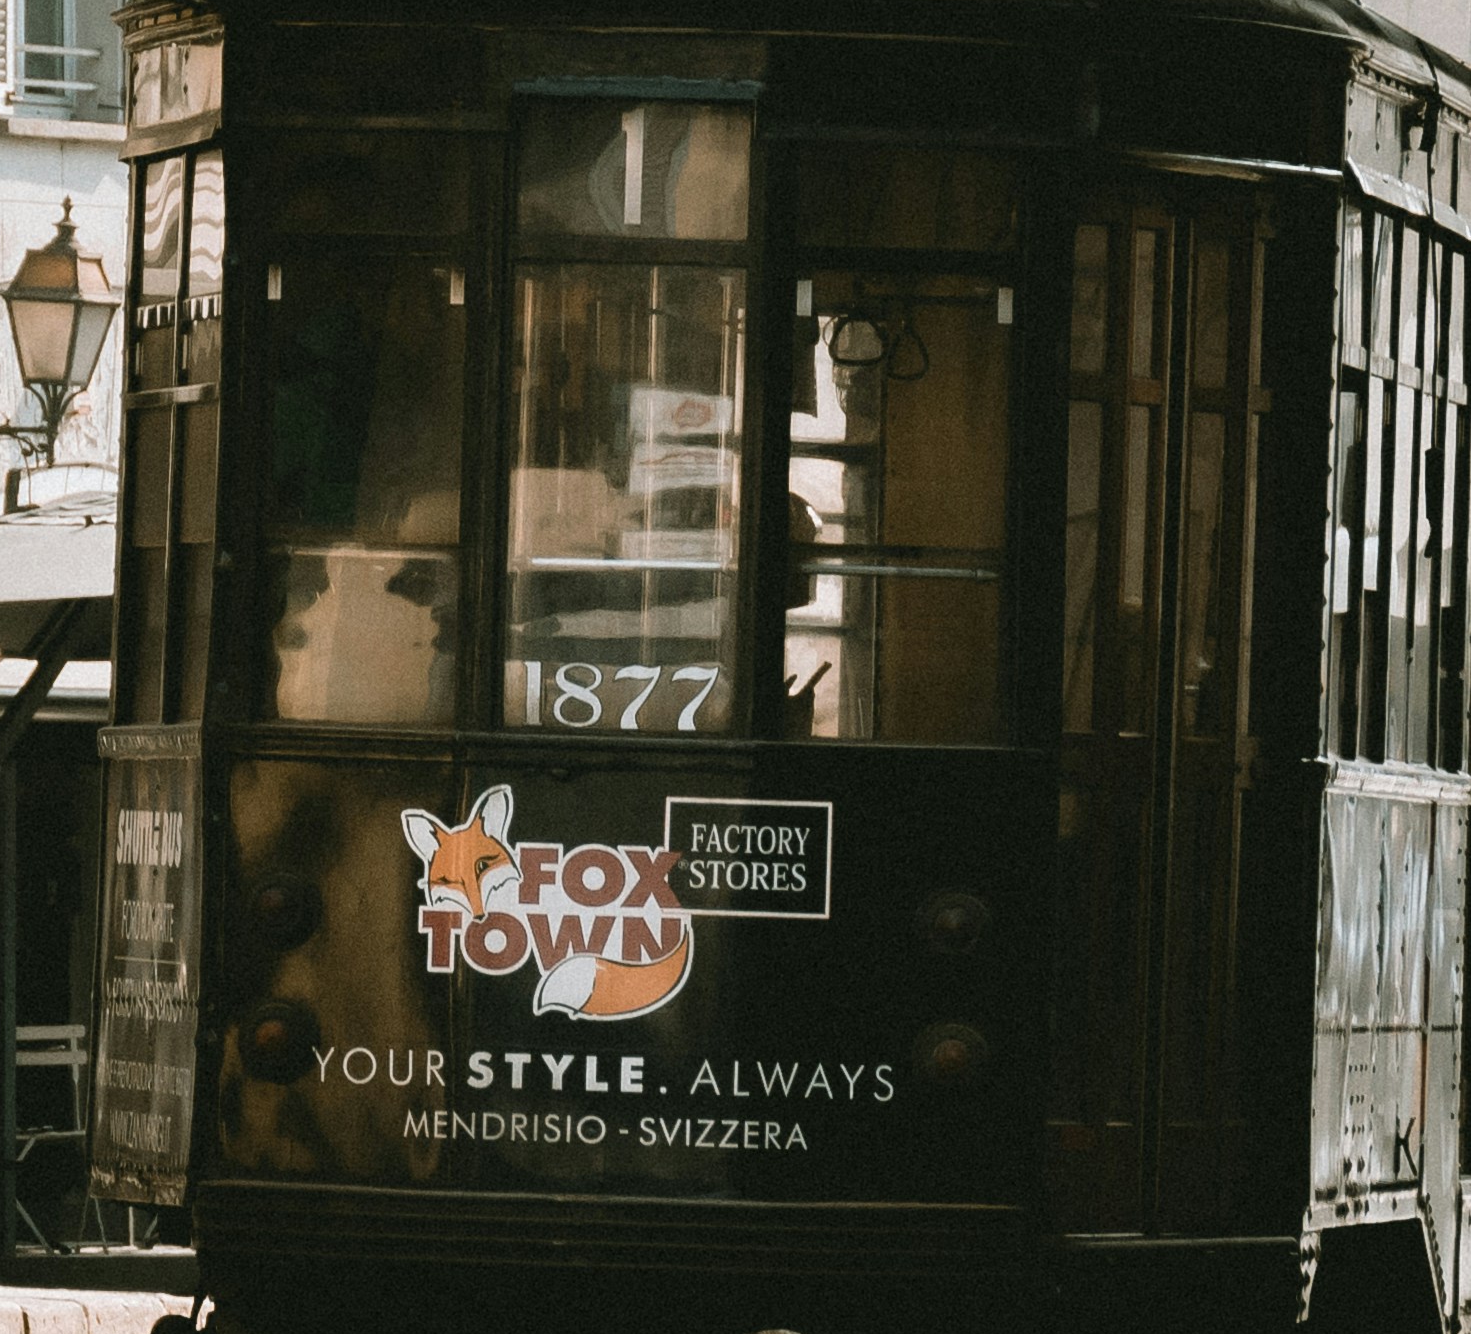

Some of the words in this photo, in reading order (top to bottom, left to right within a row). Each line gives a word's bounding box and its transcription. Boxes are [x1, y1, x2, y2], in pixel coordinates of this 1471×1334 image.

[622, 108, 644, 224] 1
[524, 661, 719, 731] 1877
[117, 809, 160, 865] SHUTTLE
[161, 811, 183, 868] BUS
[691, 822, 810, 855] FACTORY
[519, 846, 683, 907] FOX
[689, 861, 808, 892] STORES
[421, 910, 684, 970] TOWN
[313, 1046, 445, 1087] YOUR
[467, 1053, 668, 1094] STYLE.
[690, 1059, 896, 1102] ALWAYS
[404, 1109, 606, 1144] MENDRISIO
[638, 1116, 808, 1152] SVIZZERA
